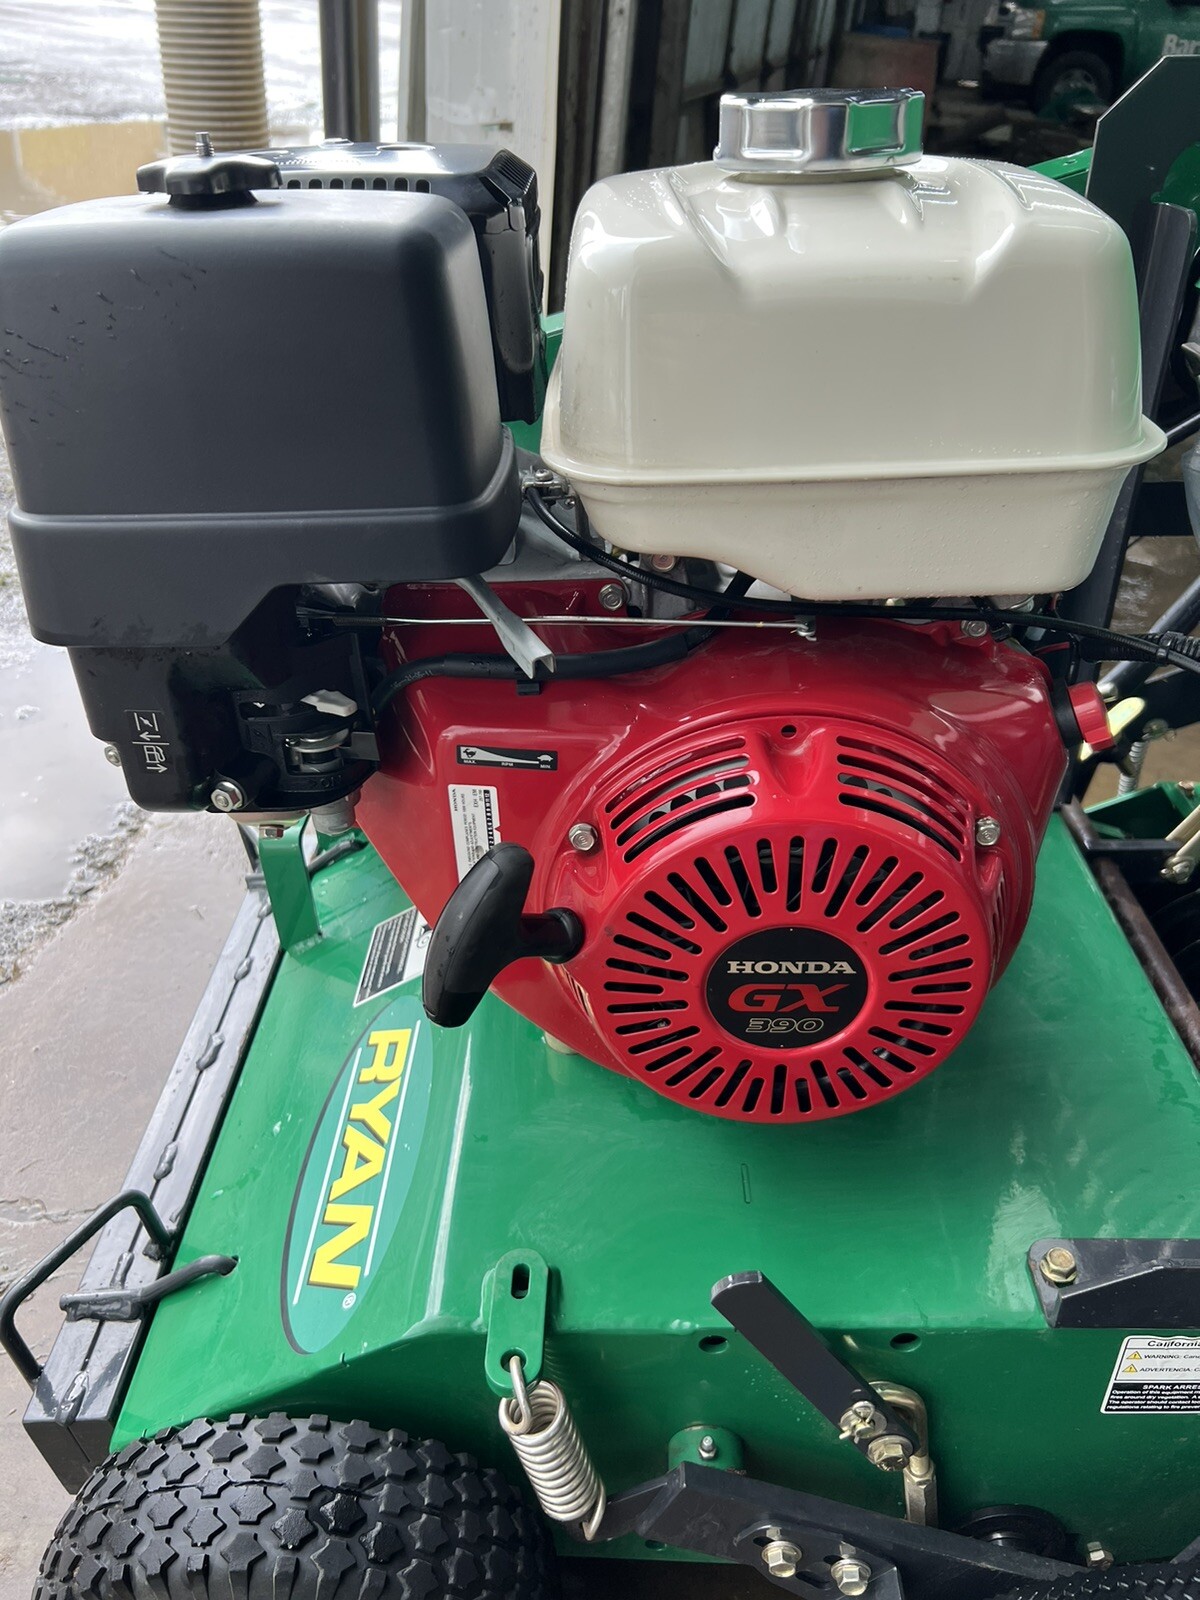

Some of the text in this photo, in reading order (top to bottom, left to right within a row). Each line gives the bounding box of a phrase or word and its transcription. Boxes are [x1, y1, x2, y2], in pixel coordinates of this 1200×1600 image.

[727, 961, 857, 974] HONDA
[728, 984, 849, 1013] GX
[746, 1018, 824, 1033] 390
[307, 1028, 412, 1289] RYAN
